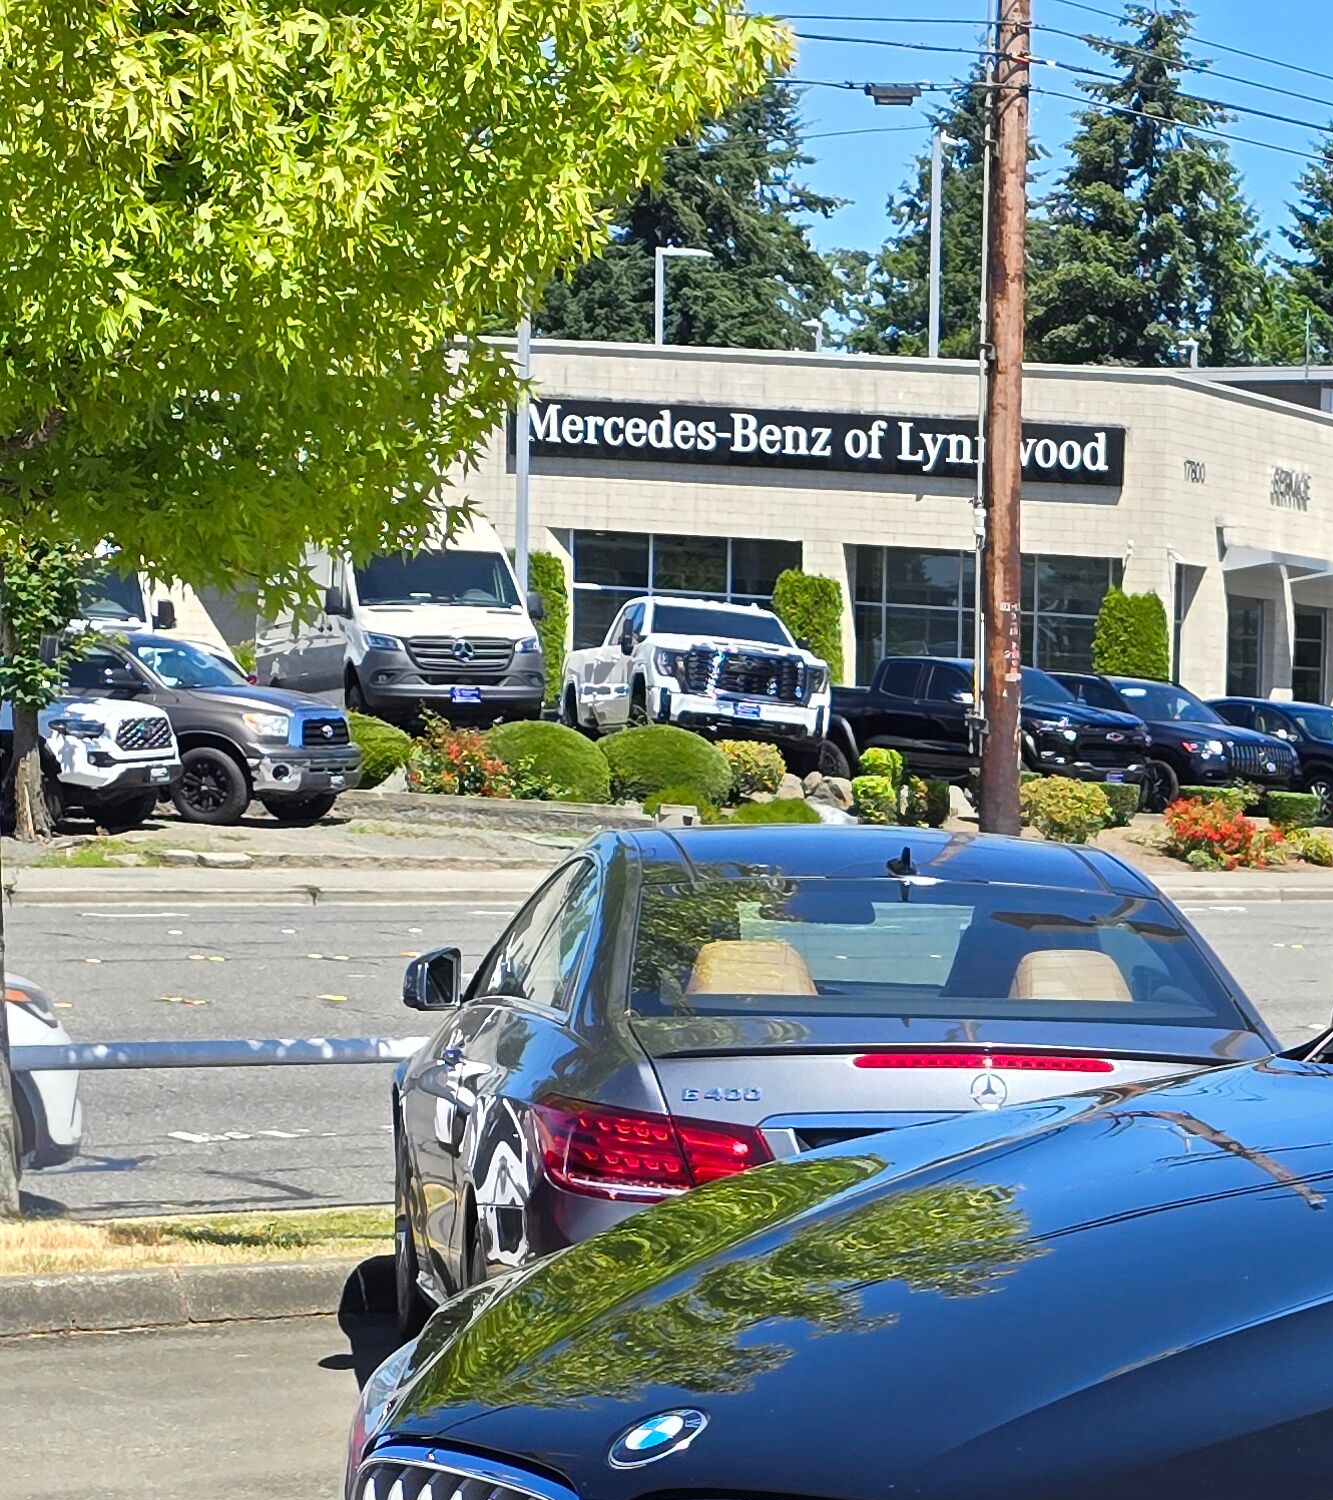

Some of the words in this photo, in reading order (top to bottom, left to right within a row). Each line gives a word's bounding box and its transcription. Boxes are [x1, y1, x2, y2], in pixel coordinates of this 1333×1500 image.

[528, 404, 831, 457] Mercedes-Benz
[845, 421, 887, 460] of
[703, 1087, 761, 1102] 400
